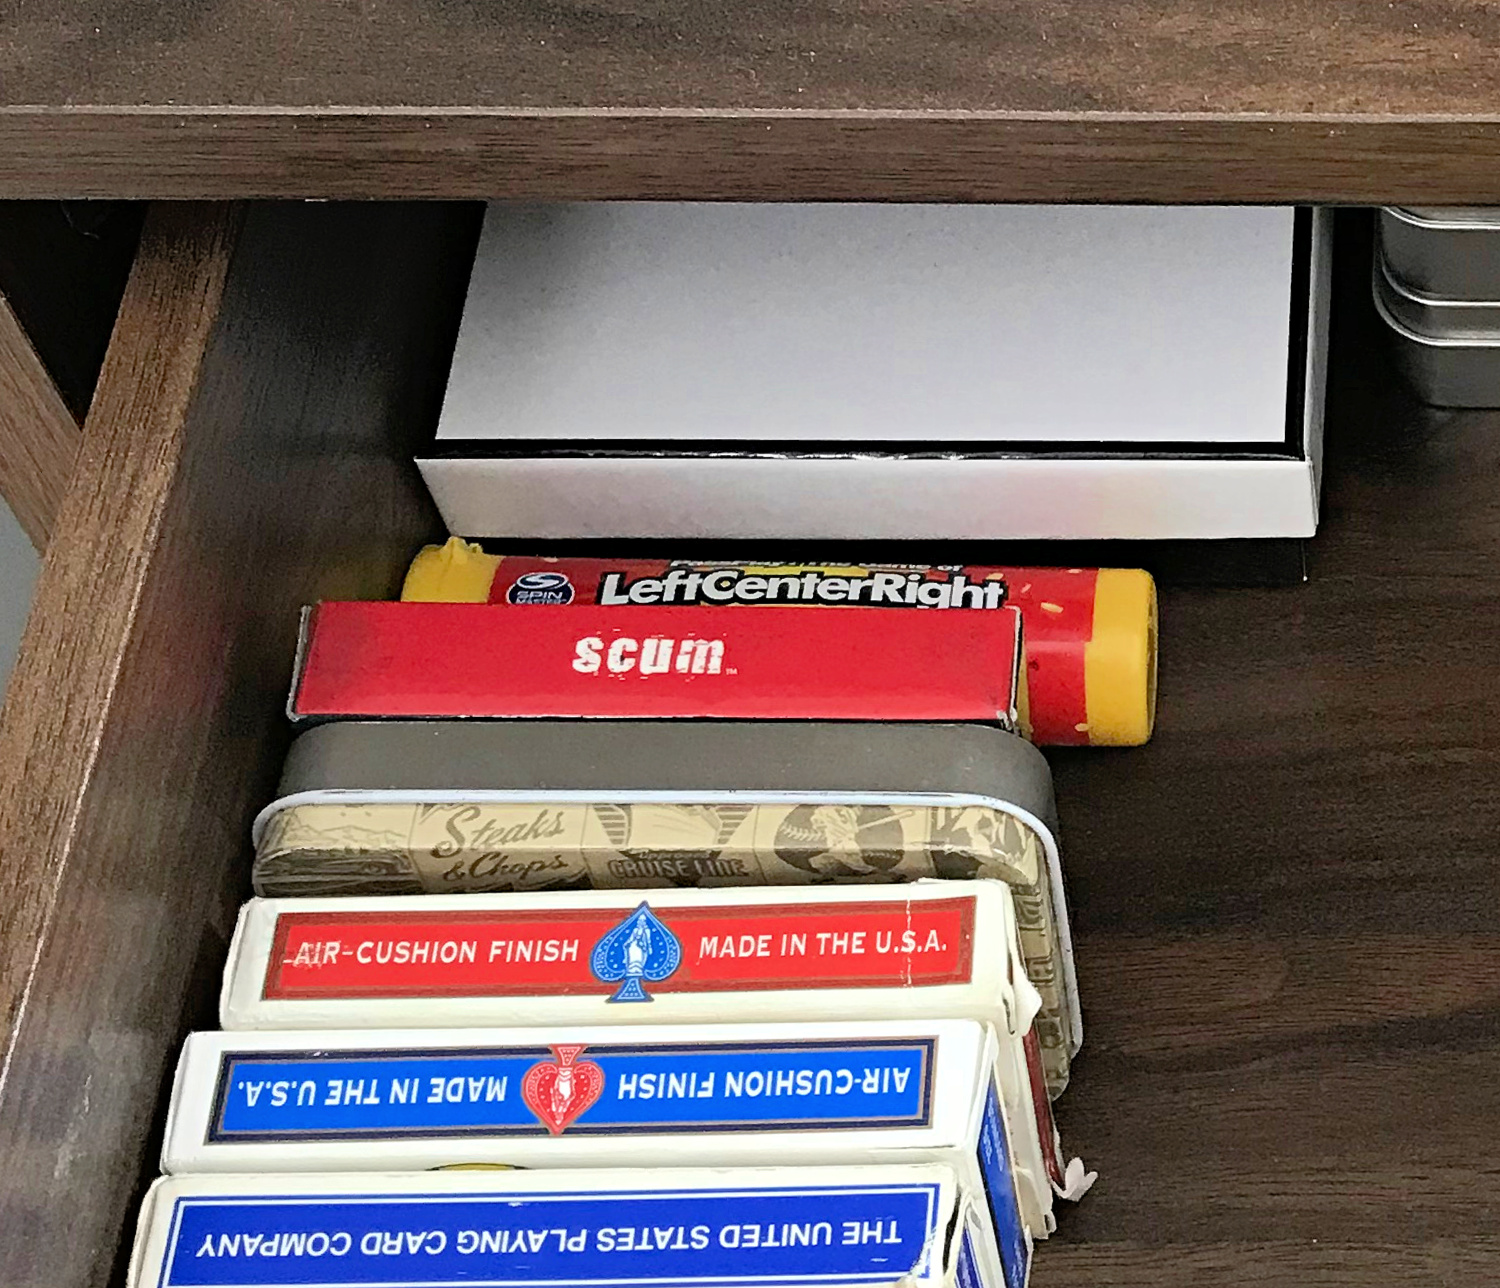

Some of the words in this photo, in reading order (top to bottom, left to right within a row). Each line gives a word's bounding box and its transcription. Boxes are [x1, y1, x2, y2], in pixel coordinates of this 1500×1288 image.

[517, 591, 563, 600] SPIN
[600, 569, 1003, 609] LeftCenterRight
[572, 634, 725, 676] scum
[430, 805, 565, 858] Steaks
[469, 851, 568, 880] Chops
[608, 859, 689, 878] CRUISE
[694, 858, 749, 876] LINE
[295, 940, 478, 967] AIR-CUSHION
[488, 939, 578, 963] FINISH
[700, 934, 771, 958] MADE
[780, 933, 807, 957] IN
[816, 931, 865, 955] THE
[875, 929, 947, 954] U.S.A.
[238, 1079, 317, 1107] U.S.A.
[328, 1078, 380, 1105] THE
[390, 1077, 419, 1103] IN
[427, 1076, 507, 1102] MADE
[618, 1071, 714, 1100] FINISH
[725, 1066, 911, 1097] AIR-CUSHION
[196, 1231, 352, 1257] COMPANY
[360, 1230, 447, 1255] CARD
[456, 1227, 587, 1255] PLAYING
[596, 1225, 710, 1252] STATES
[719, 1221, 833, 1248] UNITED
[842, 1219, 902, 1245] THE
